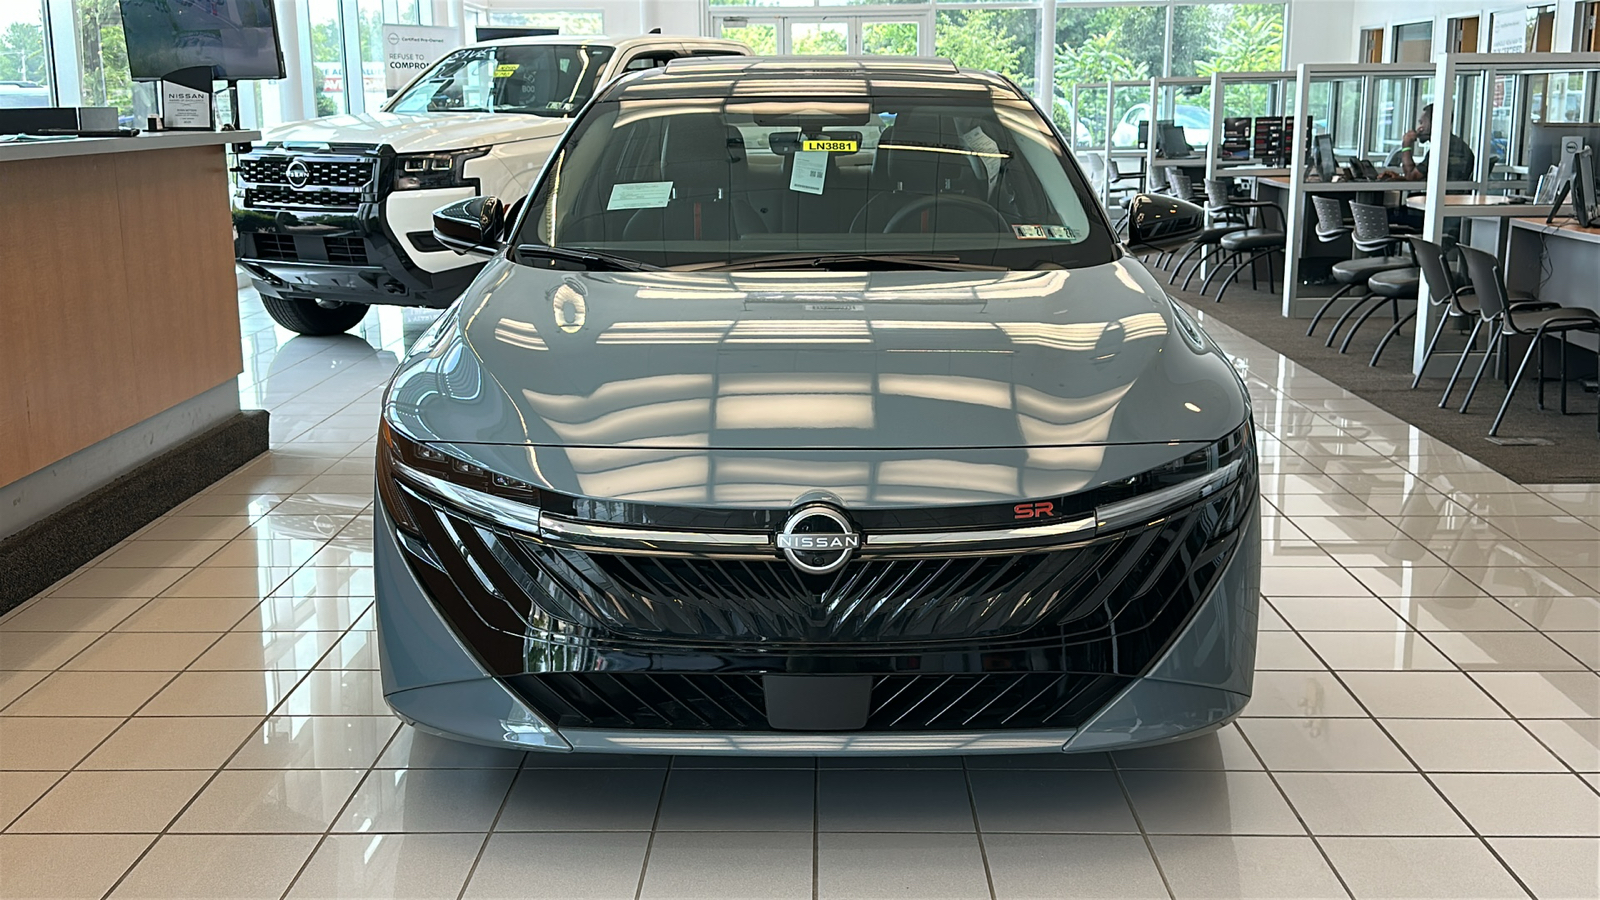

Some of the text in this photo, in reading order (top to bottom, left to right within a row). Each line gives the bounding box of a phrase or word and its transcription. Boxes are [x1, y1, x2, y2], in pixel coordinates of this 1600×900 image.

[808, 142, 852, 150] LN3881
[1013, 501, 1054, 519] SR
[780, 536, 858, 547] NISSAN
